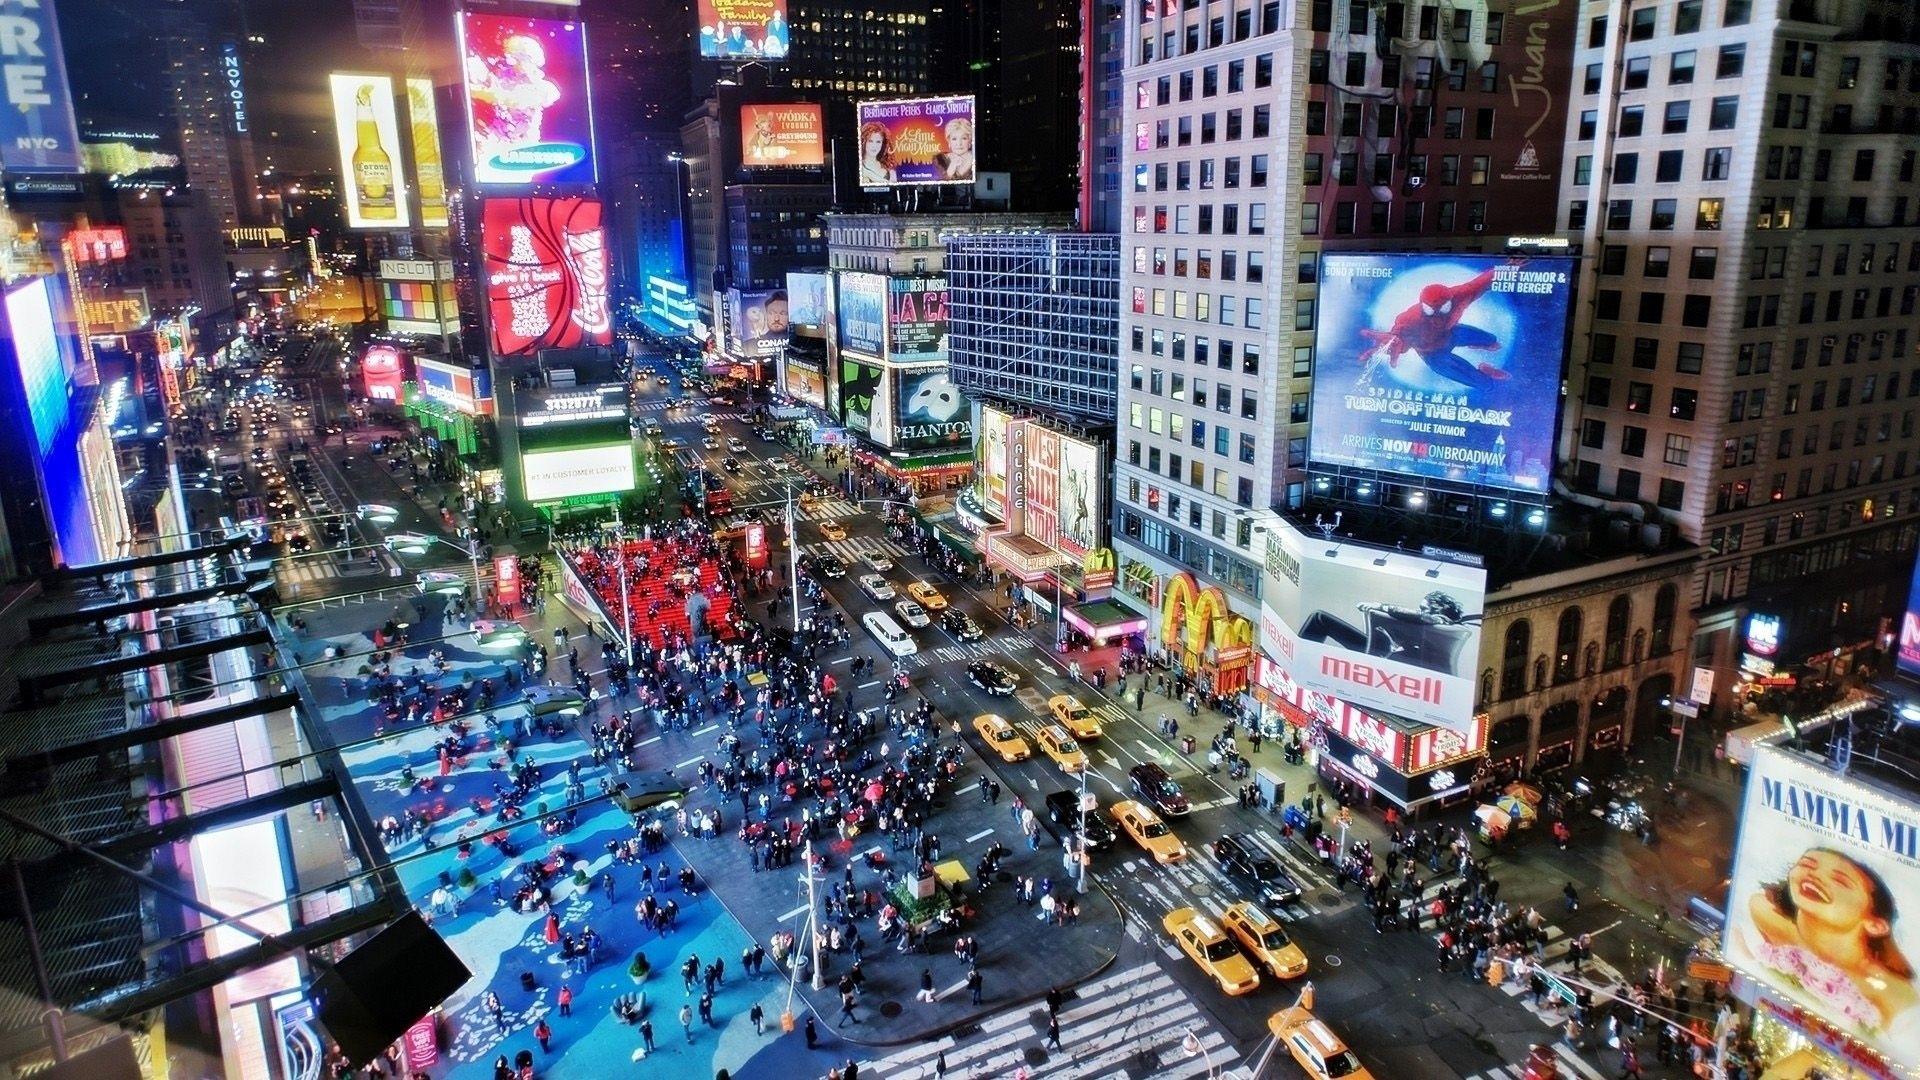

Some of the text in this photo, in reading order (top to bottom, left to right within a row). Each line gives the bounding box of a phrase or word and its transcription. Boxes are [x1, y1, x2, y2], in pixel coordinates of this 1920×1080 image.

[718, 7, 772, 26] Family
[0, 0, 51, 104] RE
[1509, 22, 1552, 138] Juan
[225, 56, 247, 132] NOVOTEL
[776, 110, 817, 122] WÓDKA
[863, 102, 970, 118] BERNADETTE PETERS ELAINE STRITCH
[16, 137, 58, 149] NYC
[888, 140, 941, 155] NIGHT MUSIC
[357, 162, 389, 173] Corona
[382, 263, 434, 275] INGLOT
[490, 271, 561, 285] give it back
[1325, 267, 1347, 276] BONO
[1356, 268, 1371, 277] THE
[1372, 268, 1393, 278] EDGE
[1492, 271, 1566, 283] JULIE TAYMOR &
[910, 279, 925, 292] BEST
[1491, 282, 1553, 294] GLEN BERGER
[86, 299, 142, 324] HEY'S
[886, 292, 917, 322] LA
[927, 366, 949, 374] belongs
[1368, 387, 1468, 406] SPIDER-MAN
[1345, 395, 1512, 426] TURN OFF THE DARK
[1409, 422, 1431, 433] JULIE
[1433, 424, 1466, 437] TAYMOR
[1028, 426, 1058, 470] WEST
[1341, 434, 1383, 450] ARRIVES
[1444, 447, 1507, 466] BROADWAY
[552, 469, 595, 479] CUSTOMER
[596, 466, 627, 475] LOYALTY
[1014, 429, 1024, 509] PALACE
[1028, 466, 1057, 512] SIDE
[1266, 536, 1300, 577] MAXIMUM
[1265, 559, 1281, 582] LIVES
[1262, 615, 1295, 663] maxell
[1322, 655, 1443, 705] maxell
[1762, 776, 1920, 860] MAMMA MI
[1785, 816, 1798, 825] THE
